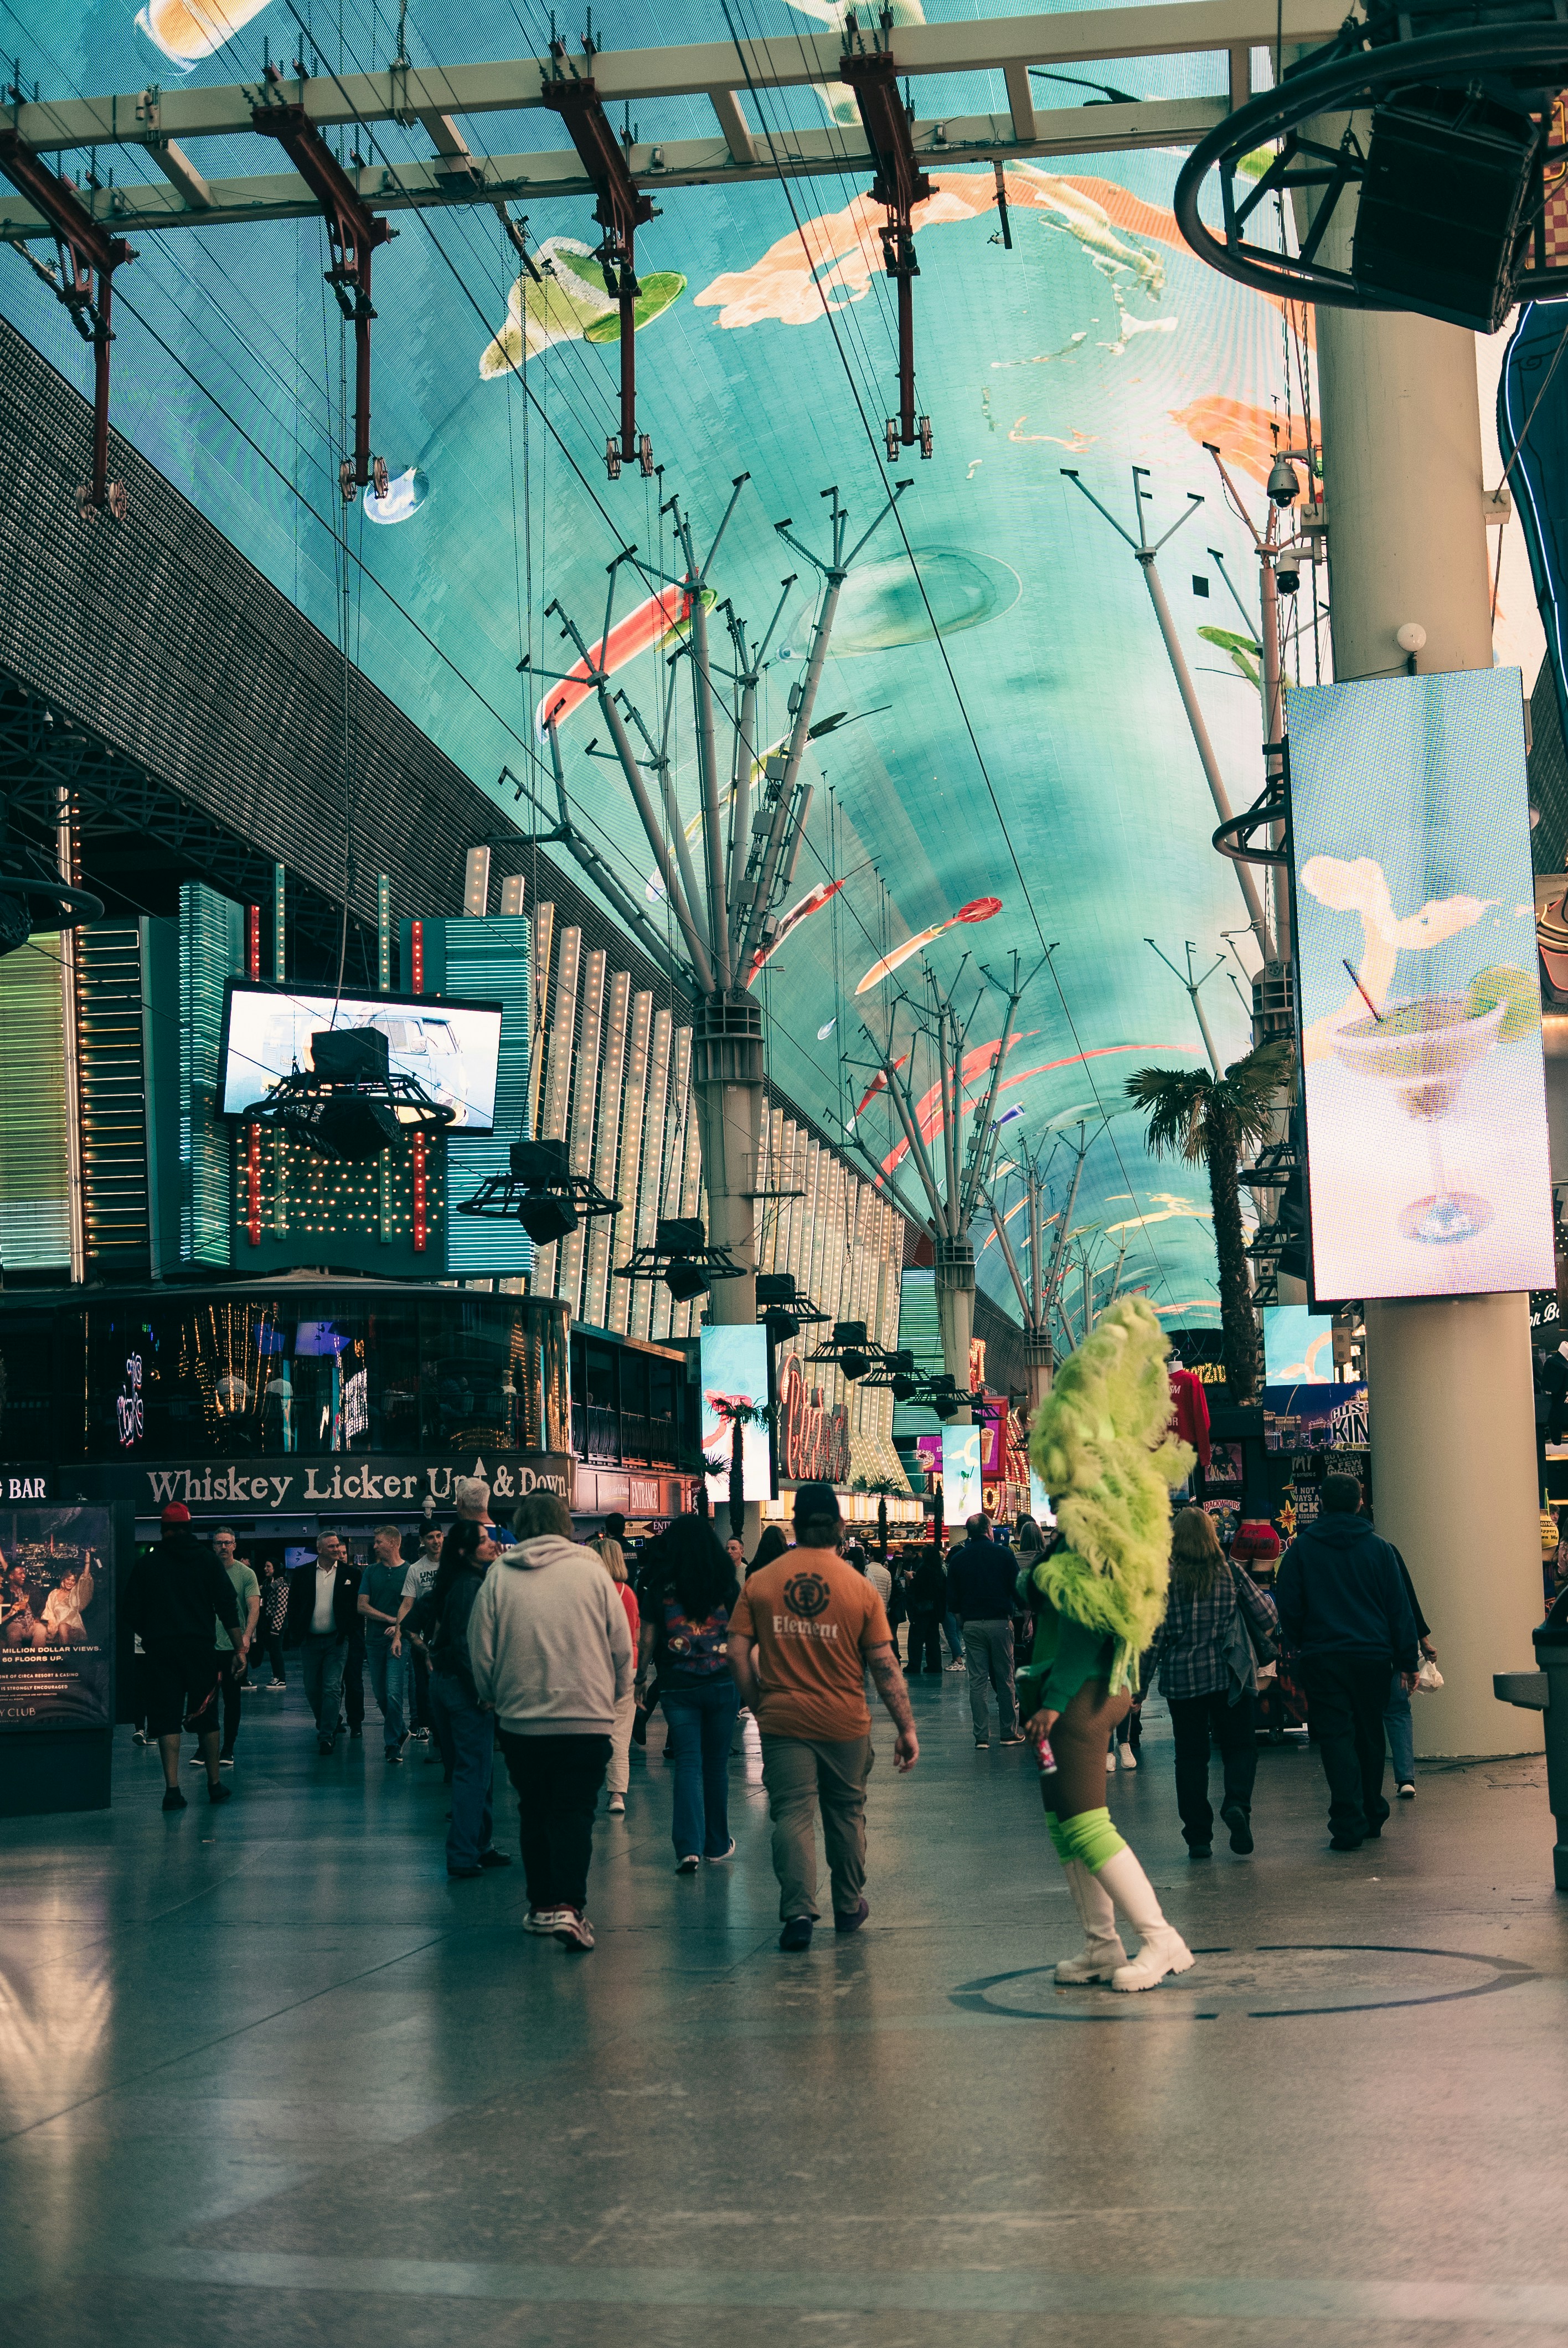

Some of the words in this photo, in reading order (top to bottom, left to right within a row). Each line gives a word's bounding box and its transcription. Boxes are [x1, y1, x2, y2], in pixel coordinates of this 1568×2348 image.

[1338, 1459, 1361, 1469] FEW
[9, 1478, 46, 1499] BAR
[147, 1466, 293, 1507] Whiskey
[303, 1464, 417, 1499] Licker
[493, 1465, 514, 1497] &
[632, 1481, 658, 1509] ENTRANCE
[1203, 1500, 1241, 1513] BACKWOODS
[773, 1615, 839, 1639] Element
[8, 1707, 36, 1717] CLUB
